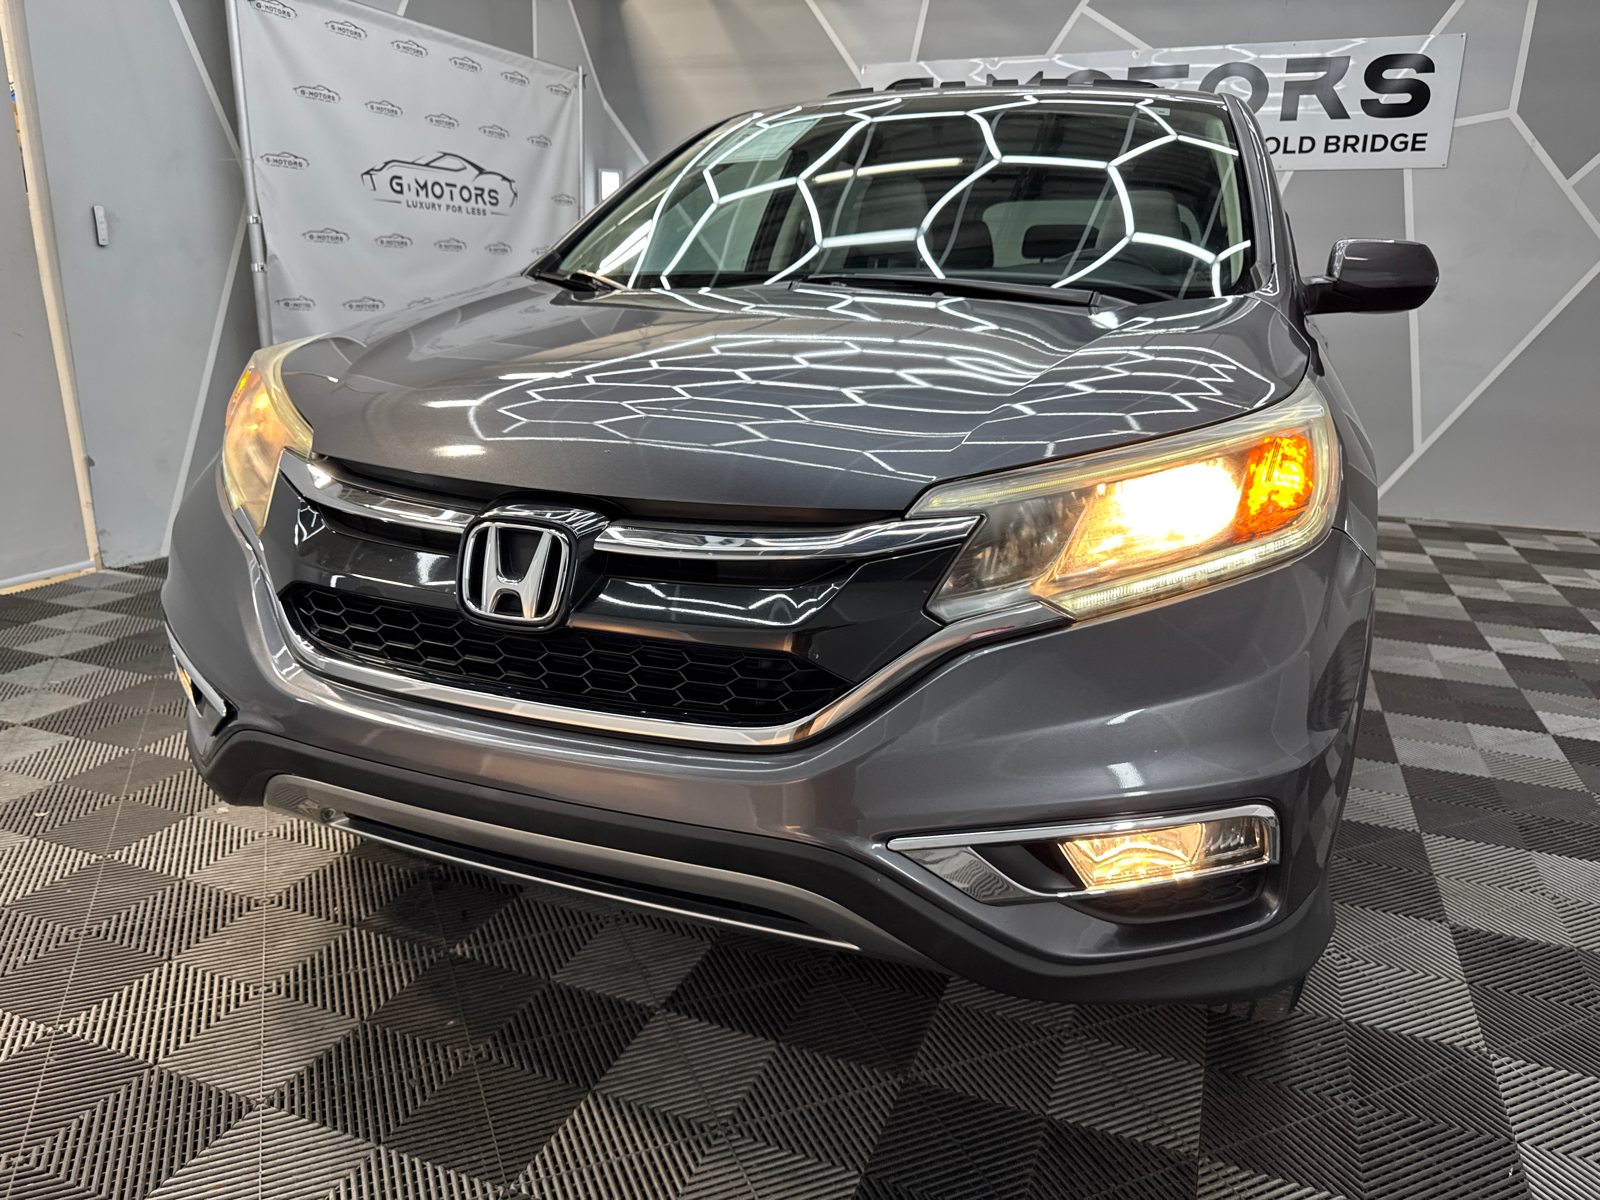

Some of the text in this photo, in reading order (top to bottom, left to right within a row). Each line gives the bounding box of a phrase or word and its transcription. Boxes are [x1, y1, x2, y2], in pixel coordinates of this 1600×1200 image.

[1264, 132, 1428, 155] OLD BRIDGE
[406, 199, 487, 216] LUXURY FOR LESS
